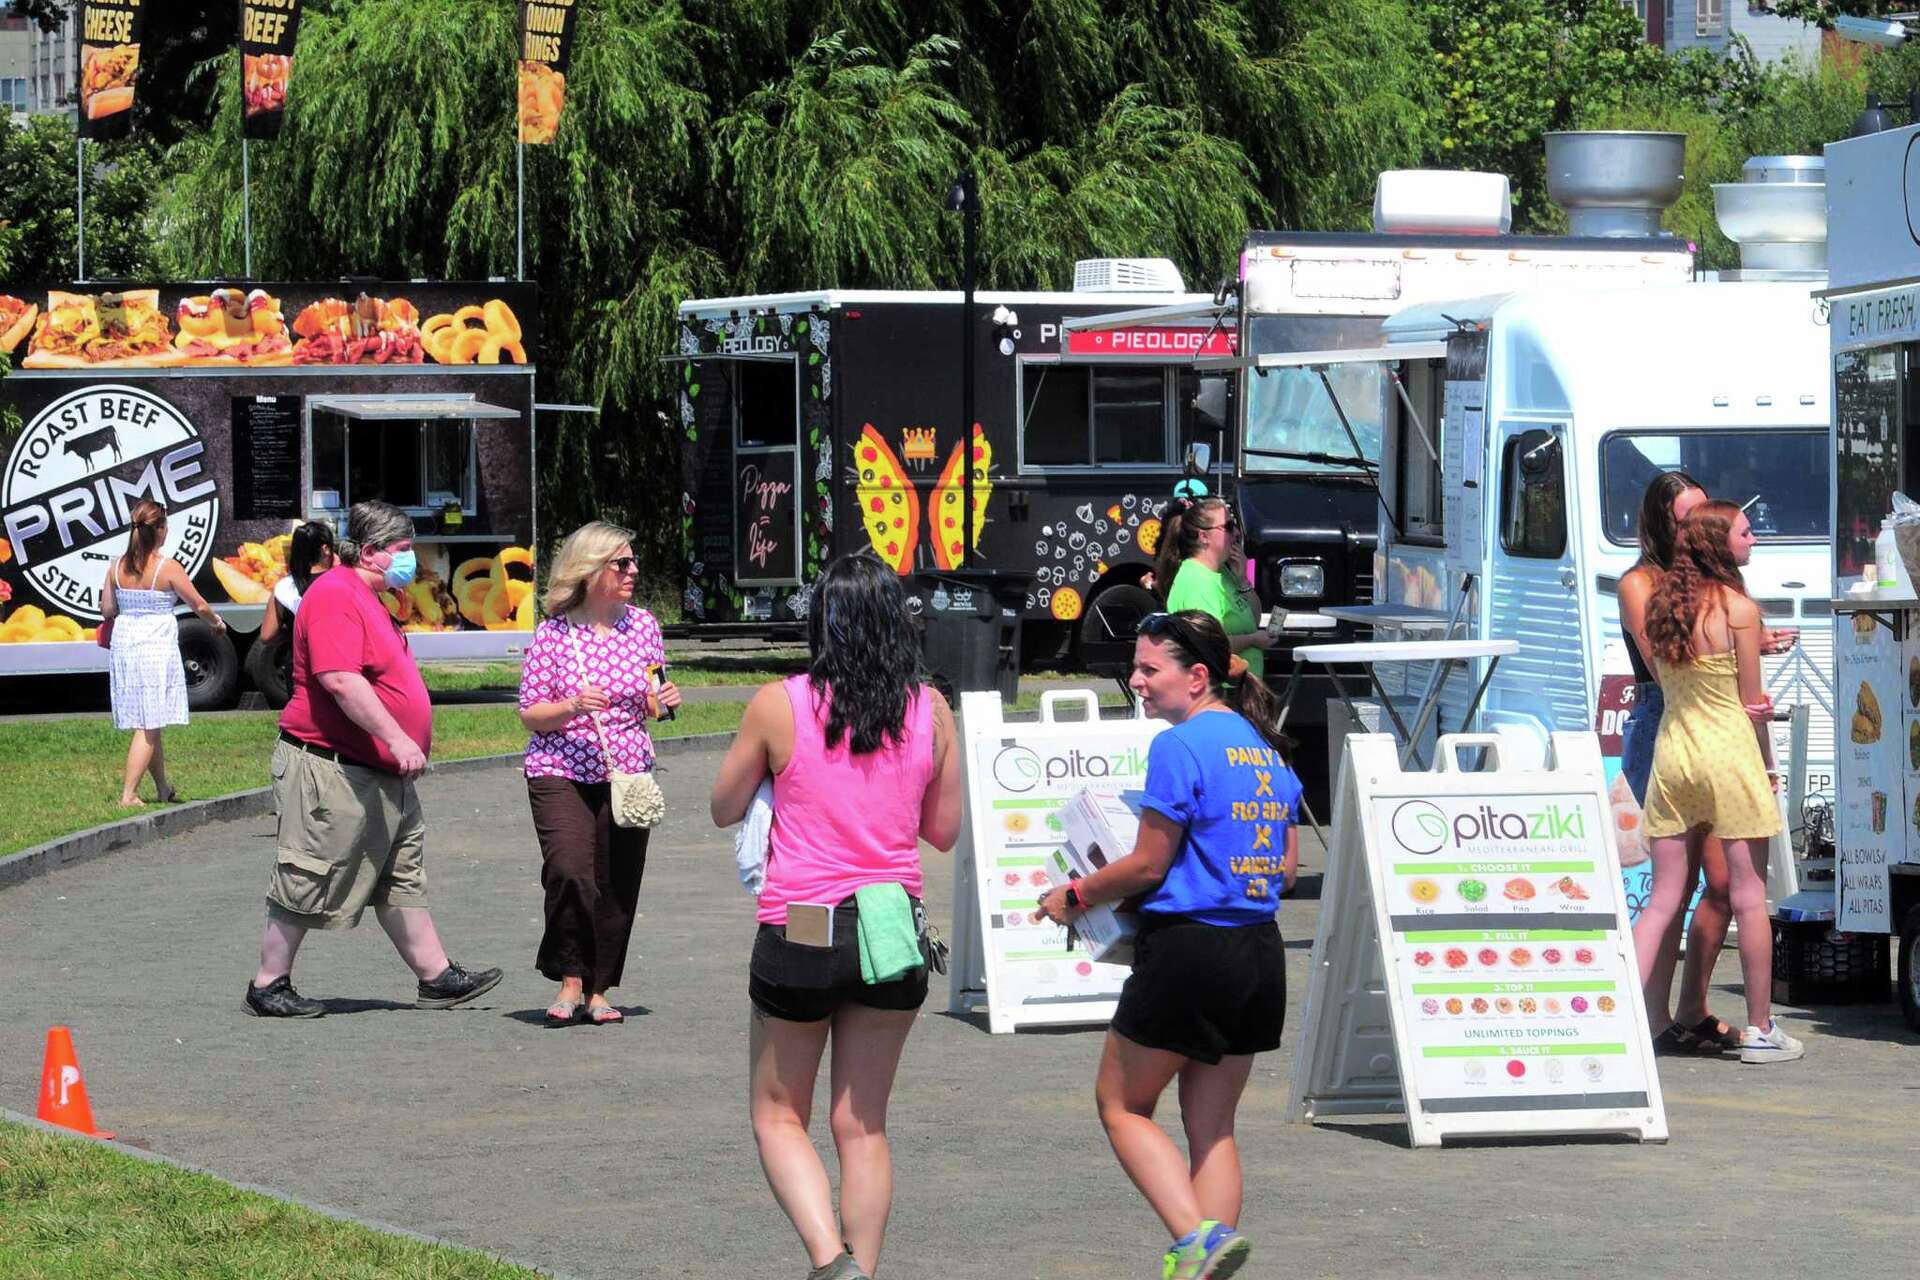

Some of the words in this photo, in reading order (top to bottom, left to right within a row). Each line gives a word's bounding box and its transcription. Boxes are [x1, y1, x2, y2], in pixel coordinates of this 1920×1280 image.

[84, 5, 134, 43] CHEESE
[243, 7, 288, 45] BEEF
[526, 2, 566, 34] ONION
[1849, 301, 1872, 337] EAT
[1112, 332, 1217, 350] PIEOLOGY
[18, 402, 88, 479] ROAST
[101, 398, 160, 429] BEEF
[740, 464, 792, 511] Pizza
[3, 440, 217, 567] PRIME
[749, 521, 778, 569] Life
[42, 565, 103, 608] STEA
[1045, 748, 1150, 787] pitazik
[1225, 747, 1274, 768] PAULY
[1254, 768, 1274, 797] X
[1231, 801, 1259, 822] FLO
[1252, 823, 1273, 850] X
[1453, 804, 1585, 849] pitaziki
[1470, 863, 1513, 873] CHOOSE
[1855, 849, 1880, 865] BOWLS
[1858, 875, 1883, 890] WRAPS
[1415, 906, 1435, 915] Rice
[1463, 903, 1489, 913] Salad
[1848, 900, 1861, 914] ALL
[1863, 899, 1883, 914] PITAS
[1505, 983, 1524, 993] TOP
[1463, 1028, 1524, 1040] UNLIMITED
[1526, 1027, 1580, 1038] TOPPINGS
